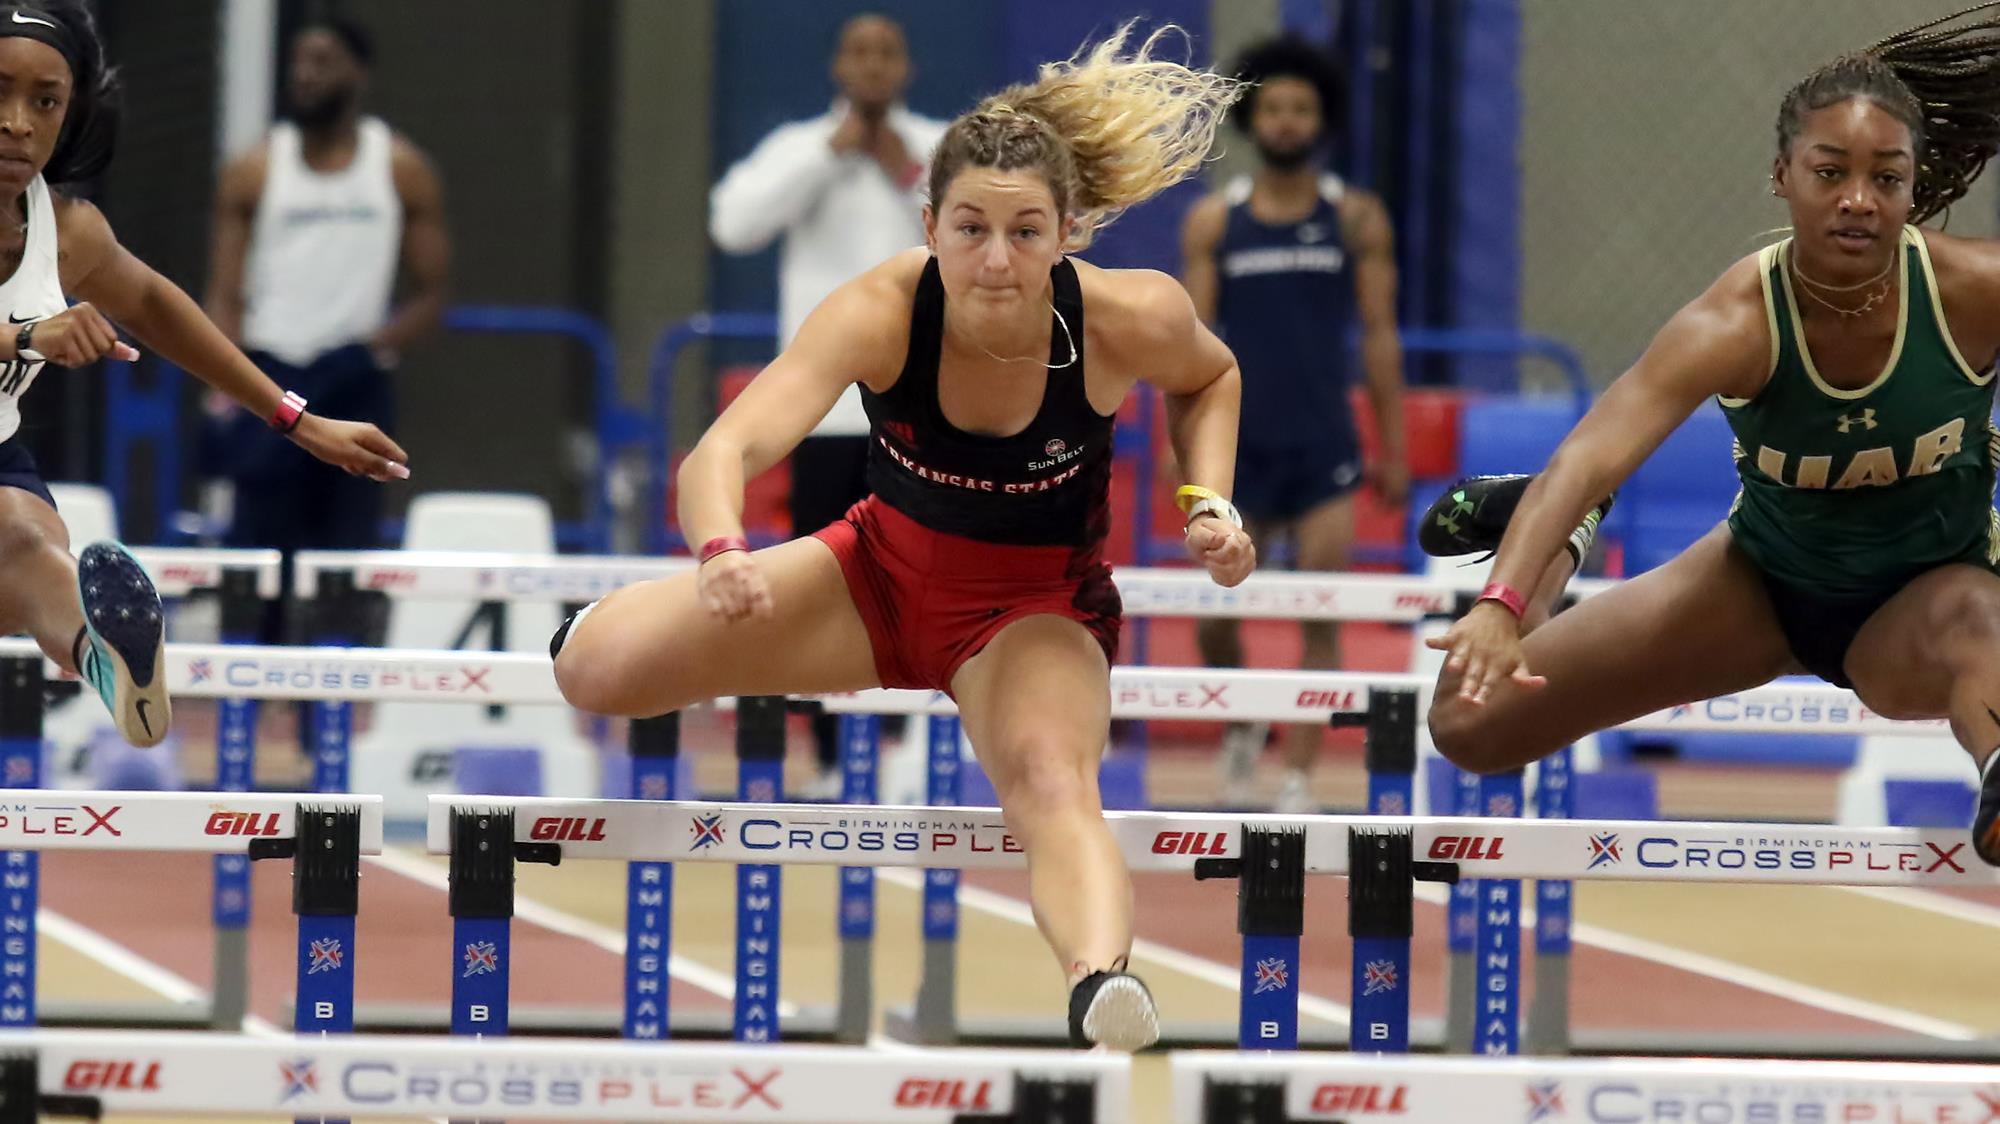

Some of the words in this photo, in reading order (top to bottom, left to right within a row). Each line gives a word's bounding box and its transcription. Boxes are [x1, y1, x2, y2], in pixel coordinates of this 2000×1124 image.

[1028, 459, 1055, 471] SUN
[1057, 445, 1085, 463] BELT
[1296, 689, 1355, 709] GILL
[204, 812, 280, 836] GILL
[530, 816, 606, 841] GILL
[739, 819, 1025, 852] CROSSPLE
[838, 819, 976, 830] BIRMINGHAM
[1152, 831, 1228, 855] GILL
[1428, 836, 1504, 860] GILL
[1735, 838, 1872, 849] BIRMINGHAM
[634, 866, 663, 1038] RMINGHAM
[743, 871, 771, 1041] RMINGHAM
[1485, 887, 1511, 1055] RMINGHAM
[63, 1060, 161, 1091] GILL
[894, 1078, 995, 1110] GILL
[1311, 1083, 1409, 1113] GILL
